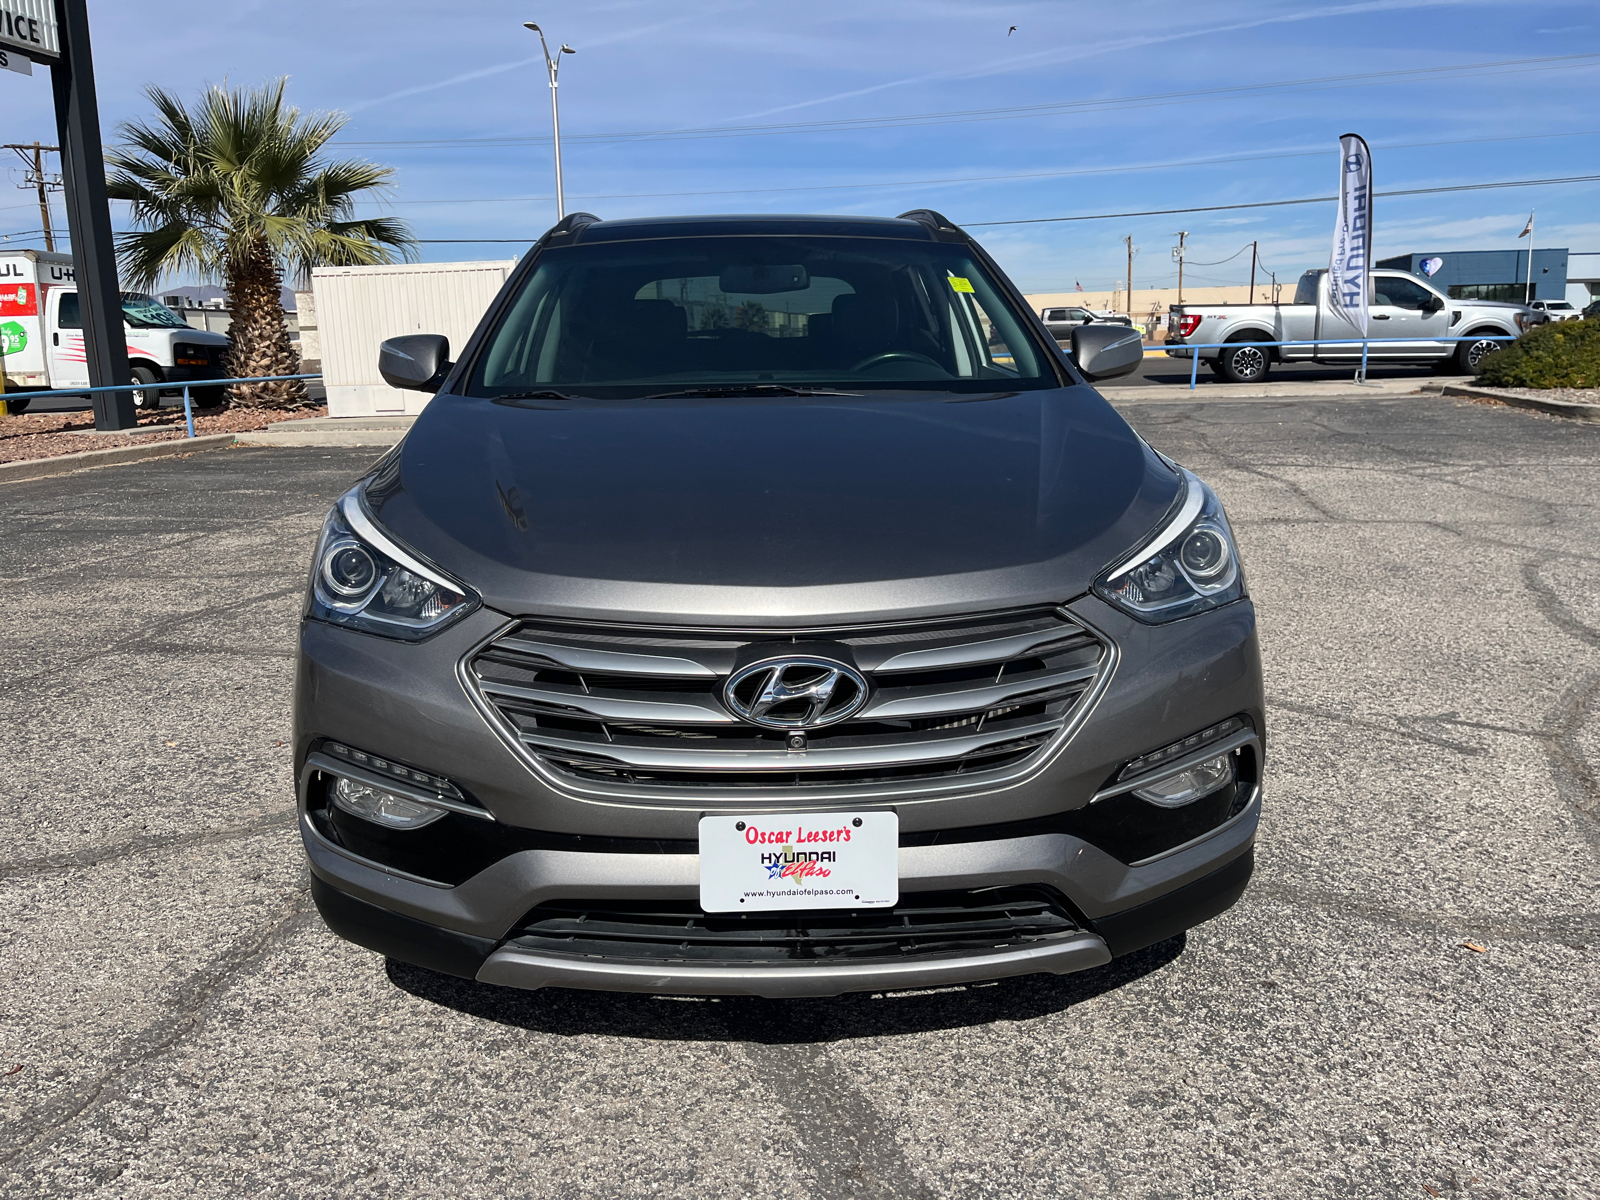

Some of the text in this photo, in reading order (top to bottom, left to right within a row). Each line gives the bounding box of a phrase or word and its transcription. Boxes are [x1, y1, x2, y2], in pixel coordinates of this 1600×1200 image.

[745, 825, 852, 845] Oscar Leeser's
[760, 851, 836, 865] HYUNDAI
[798, 860, 832, 878] Paso
[743, 888, 854, 898] www.hyundaiofelpaso.com
